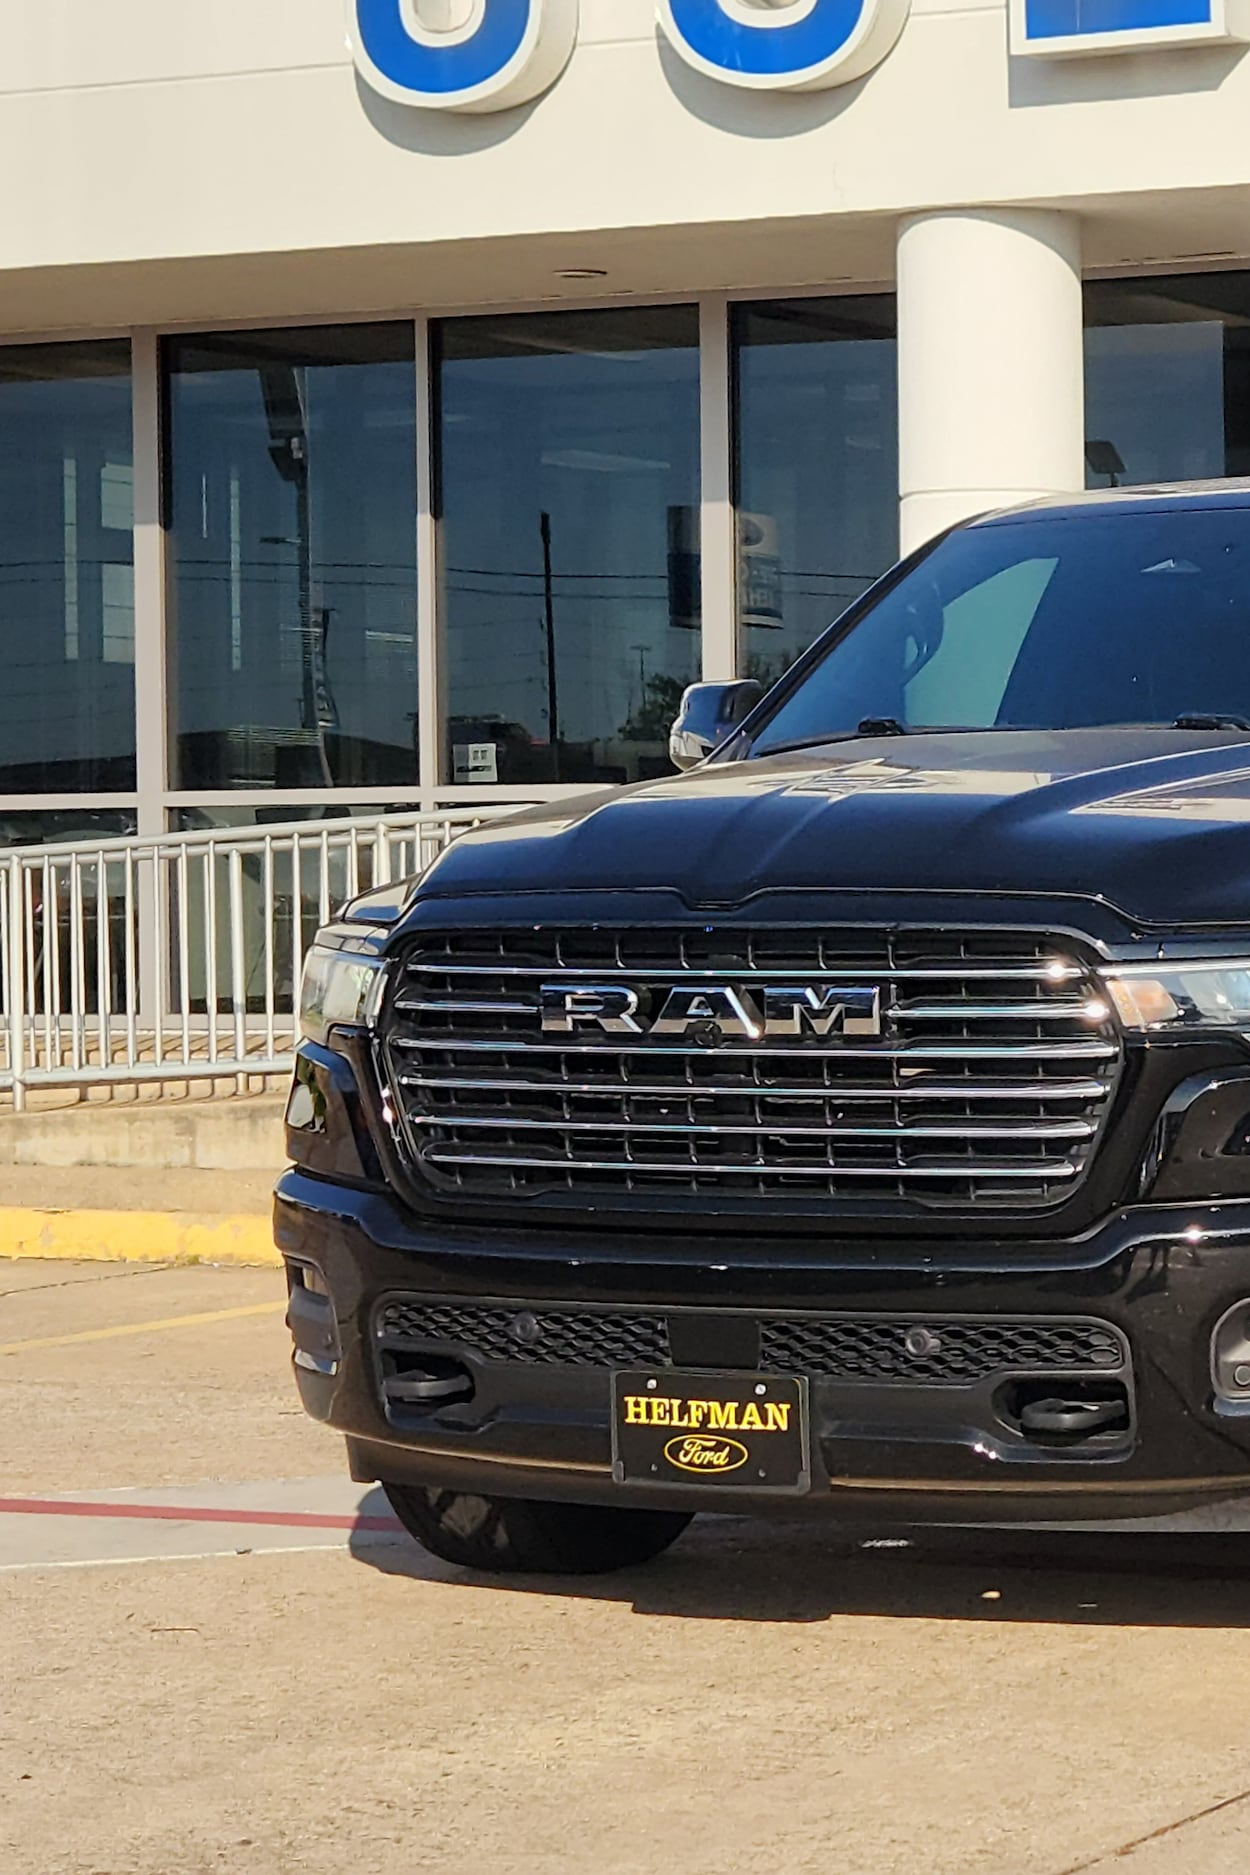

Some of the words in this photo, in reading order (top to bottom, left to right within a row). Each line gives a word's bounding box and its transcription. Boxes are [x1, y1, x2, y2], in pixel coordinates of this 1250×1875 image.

[540, 984, 881, 1036] RAM
[623, 1396, 791, 1432] HELFMAN
[678, 1438, 731, 1466] Ford
